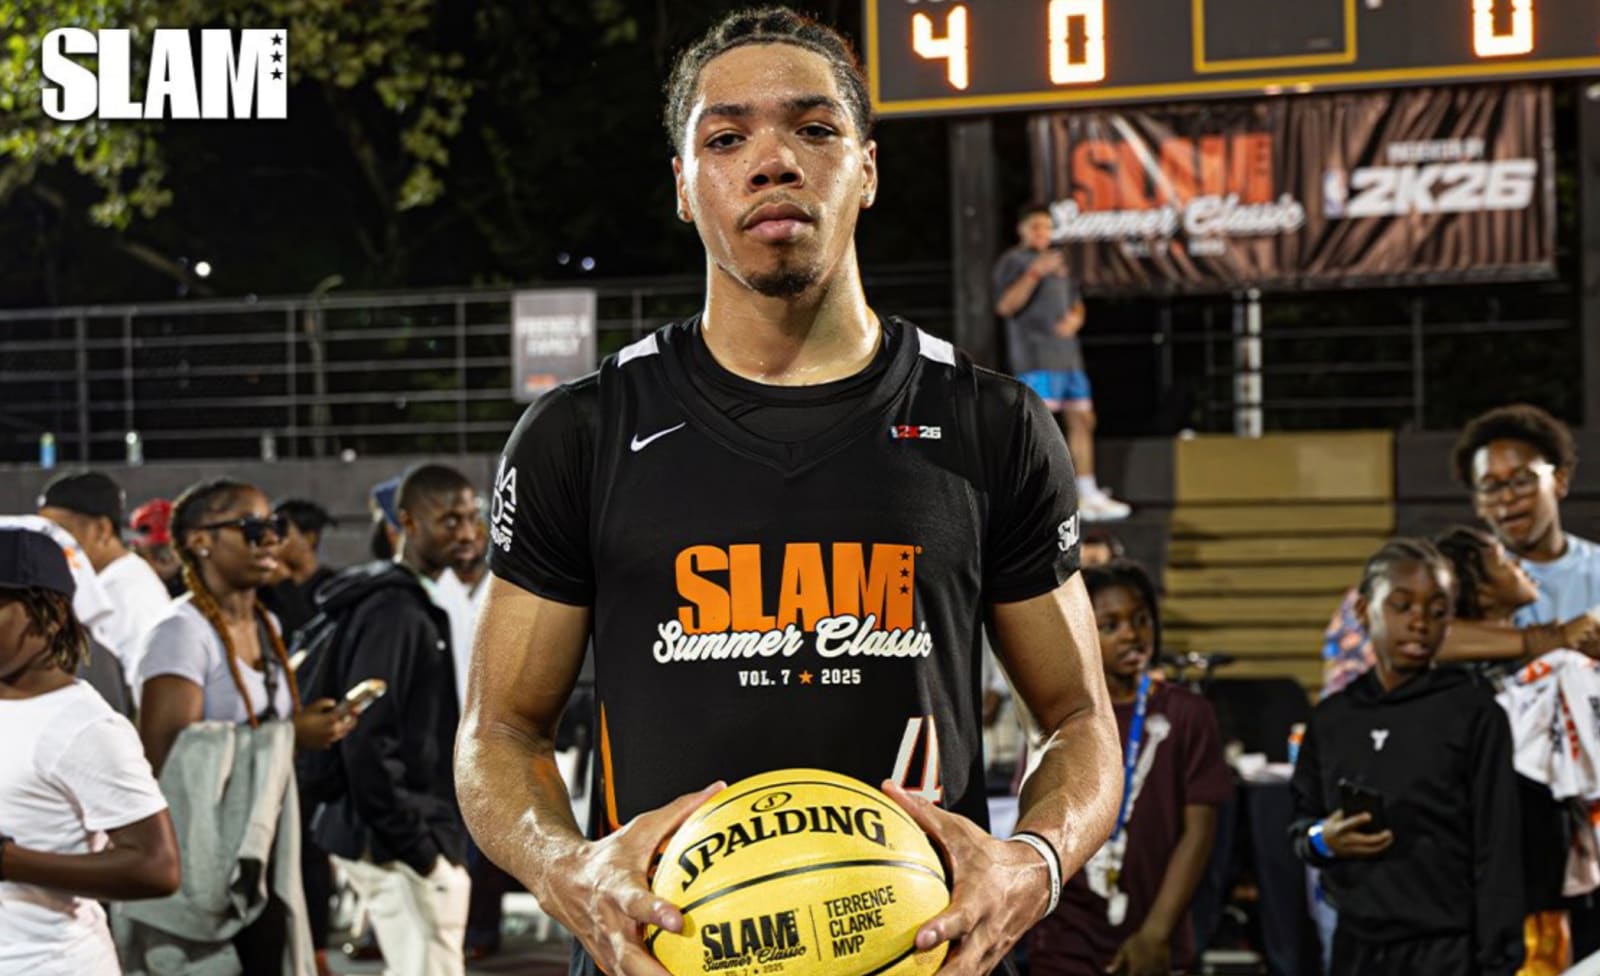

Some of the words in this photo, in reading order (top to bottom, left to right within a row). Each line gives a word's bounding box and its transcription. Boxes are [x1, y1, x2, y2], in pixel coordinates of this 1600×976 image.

[912, 5, 968, 90] 4
[1049, 0, 1105, 84] 0
[1072, 133, 1273, 213] SLAM
[1347, 158, 1537, 218] 2K26
[1185, 192, 1304, 238] Classic
[675, 542, 916, 635] SLAM
[653, 619, 804, 664] Summer
[815, 614, 933, 658] Classic
[738, 671, 776, 686] VOL.
[781, 670, 791, 684] 7
[821, 669, 861, 684] 2025
[677, 806, 887, 893] SPALDING
[823, 885, 896, 918] TERRENCE
[829, 909, 884, 938] CLARKE
[701, 909, 800, 960] SLAM
[832, 934, 865, 958] MVP
[702, 950, 752, 973] Summer
